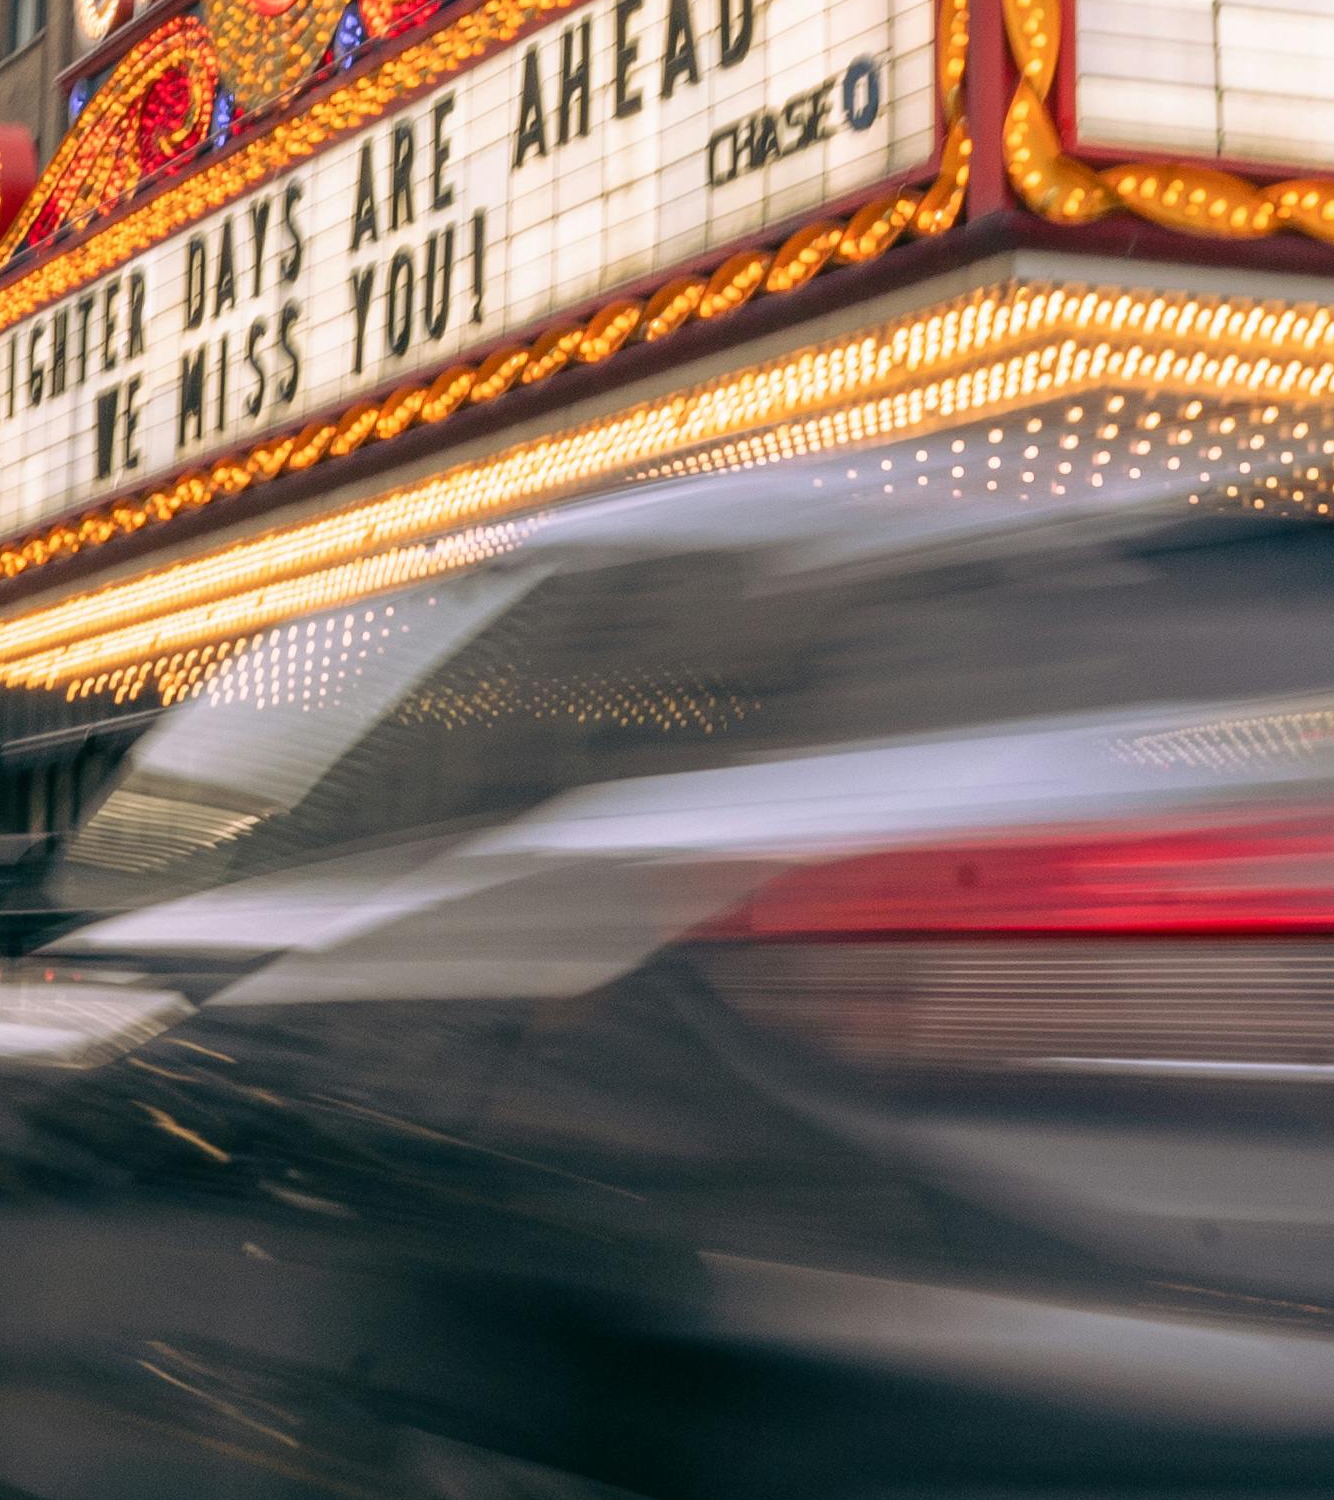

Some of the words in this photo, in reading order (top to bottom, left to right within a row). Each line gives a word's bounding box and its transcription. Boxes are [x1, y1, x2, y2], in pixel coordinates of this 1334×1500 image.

[183, 180, 305, 330] DAYS
[351, 94, 457, 252] ARE
[707, 80, 837, 188] CHASE
[93, 386, 139, 480] WE
[177, 300, 301, 446] MISS
[351, 208, 487, 374] YOU!
